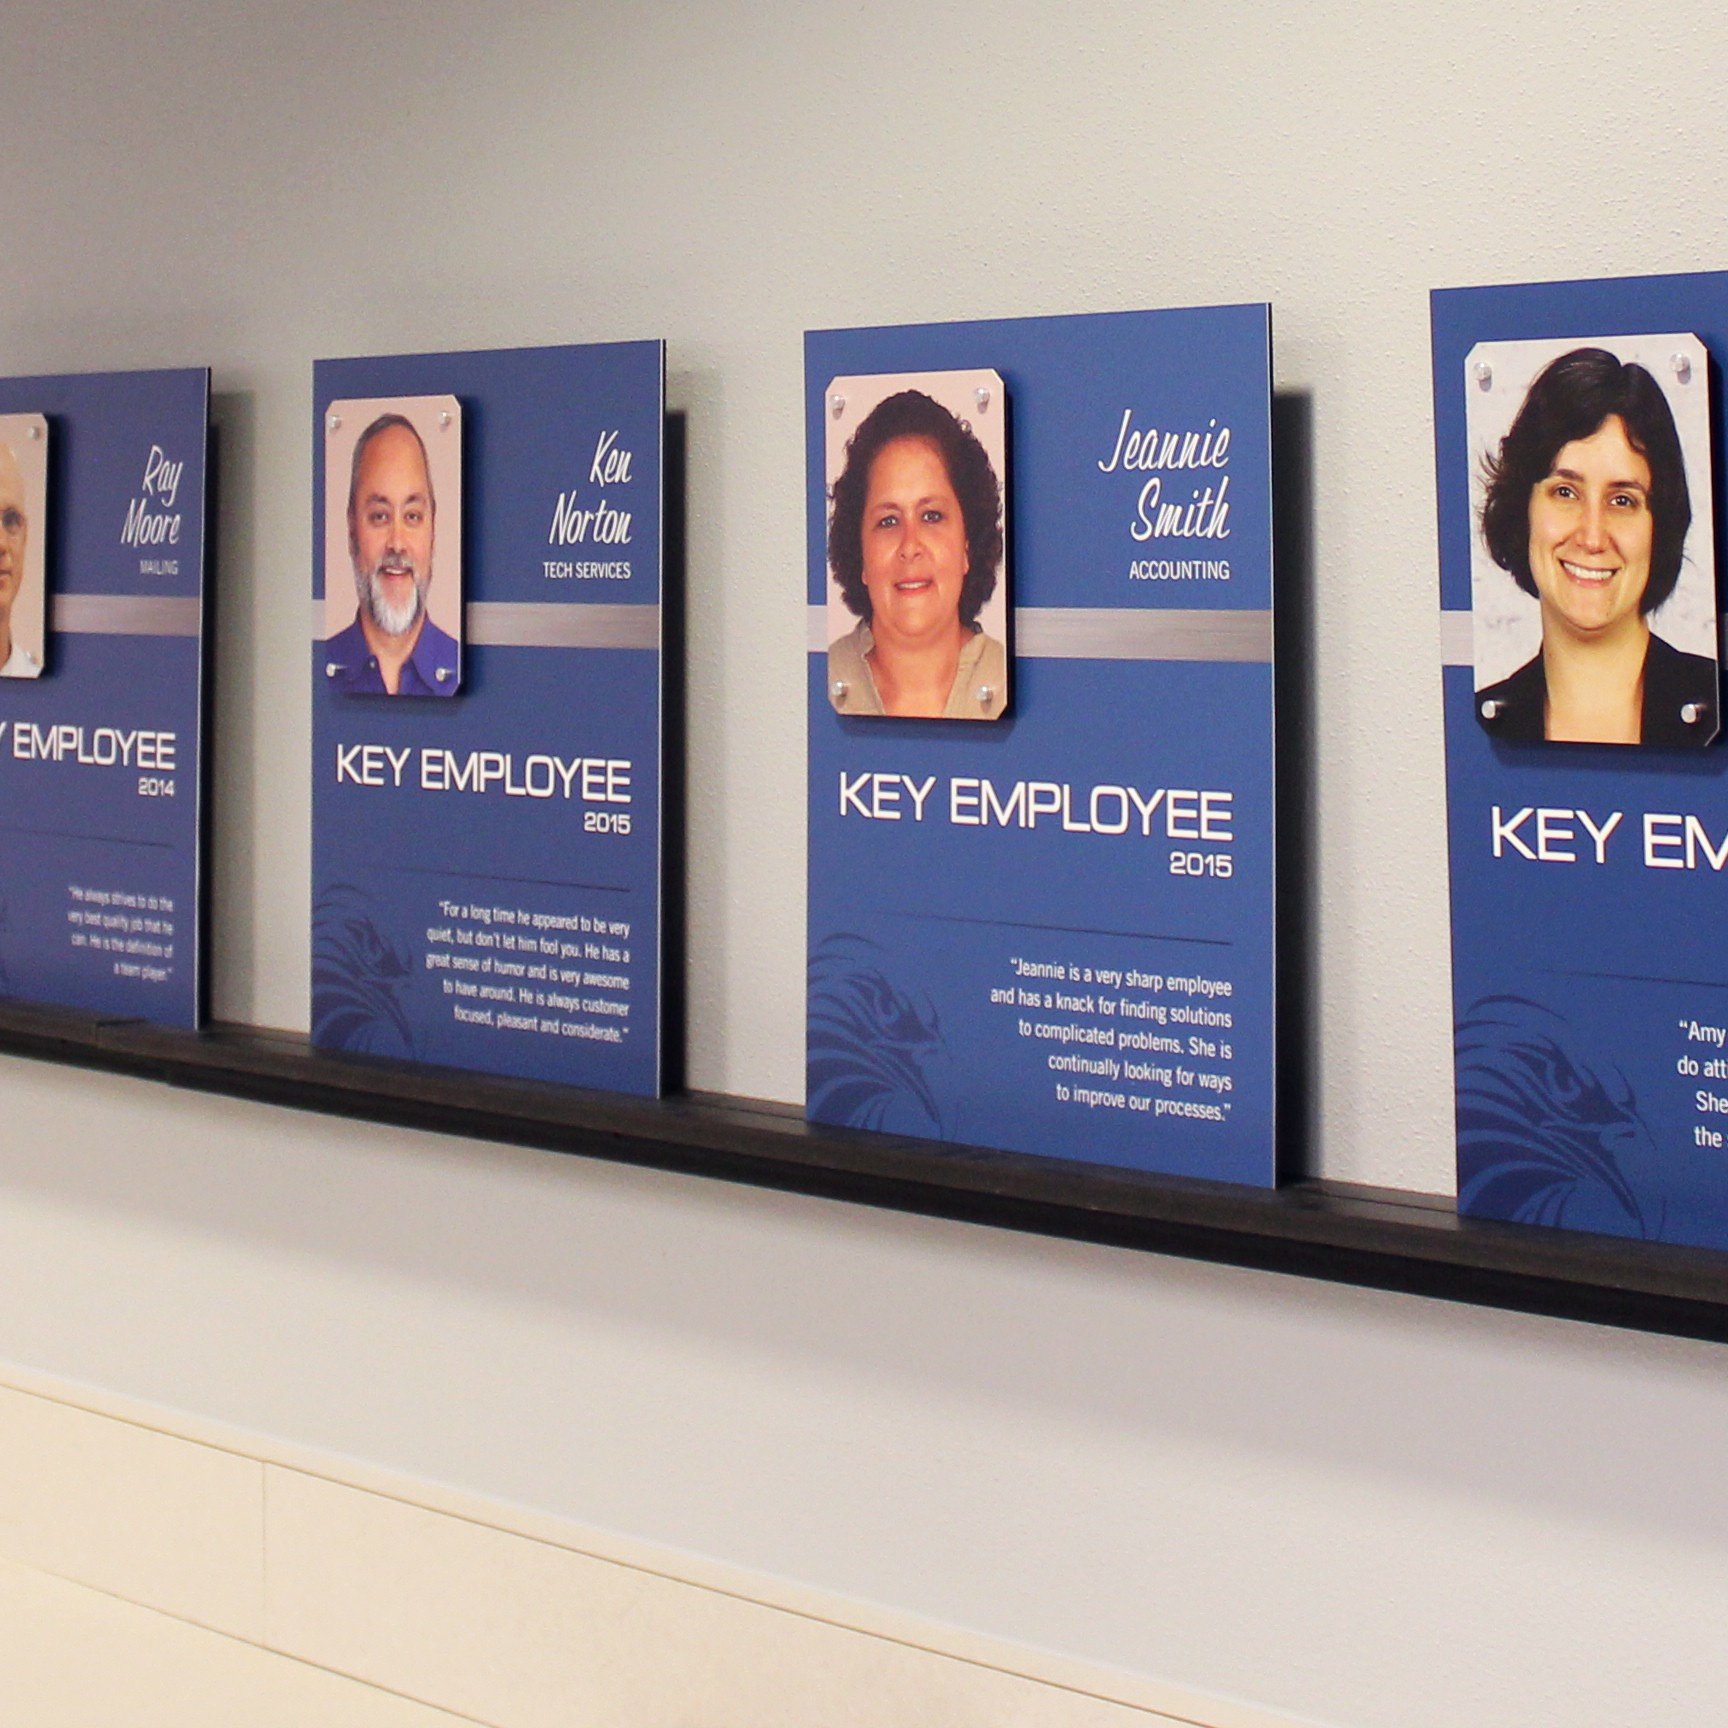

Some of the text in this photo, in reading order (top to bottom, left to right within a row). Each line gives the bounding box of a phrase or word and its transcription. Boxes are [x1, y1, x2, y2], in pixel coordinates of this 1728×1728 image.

[590, 431, 631, 487] Ken
[1099, 409, 1229, 472] Jeannie
[143, 445, 183, 507] Ray
[121, 498, 180, 547] Moore
[549, 490, 631, 545] Norton
[1131, 476, 1230, 540] Smith
[543, 562, 631, 578] TECH SERVICES
[1130, 561, 1229, 579] ACCOUNTING
[14, 723, 175, 770] EMPLOYEE
[139, 778, 174, 796] 2014
[338, 744, 631, 802] KEY EMPLOYEE
[584, 812, 630, 834] 2015
[841, 772, 1233, 841] KEY EMPLOYEE
[1492, 806, 1622, 863] KEY
[1170, 852, 1232, 877] 2015
[1070, 963, 1080, 981] is
[1083, 968, 1092, 982] a
[1096, 970, 1122, 989] very
[1126, 970, 1163, 992] sharp
[1167, 976, 1232, 998] employee
[991, 988, 1232, 1028] and has a knack for finding solutions
[1019, 1019, 1232, 1059] to complicated problems. She is
[1049, 1055, 1232, 1093] continually looking for ways
[1678, 1056, 1698, 1075] do
[1057, 1084, 1069, 1101] to
[1074, 1089, 1125, 1108] improve
[1129, 1096, 1151, 1110] our
[1696, 1091, 1728, 1113] She
[1695, 1126, 1722, 1147] the
